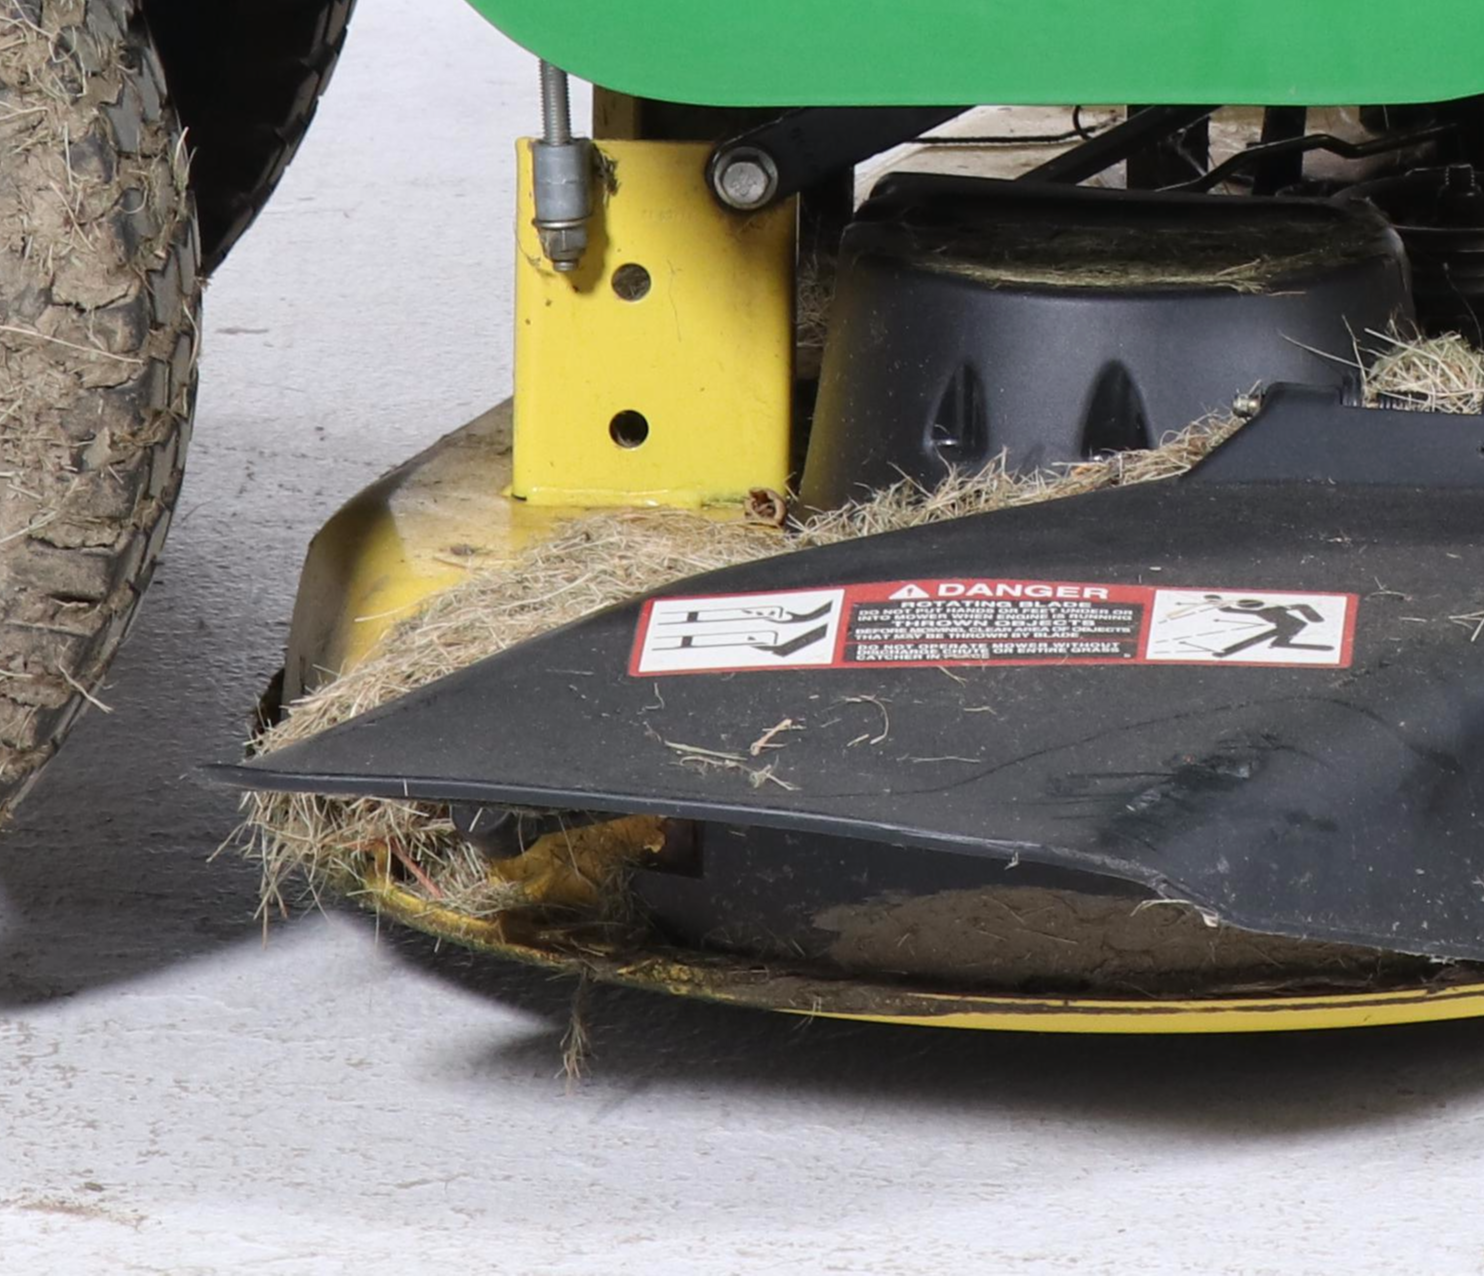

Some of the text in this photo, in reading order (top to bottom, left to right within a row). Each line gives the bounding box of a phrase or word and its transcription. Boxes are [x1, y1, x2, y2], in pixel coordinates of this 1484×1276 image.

[937, 582, 1109, 600] DANGER
[901, 600, 1092, 608] ROTATING BLADE
